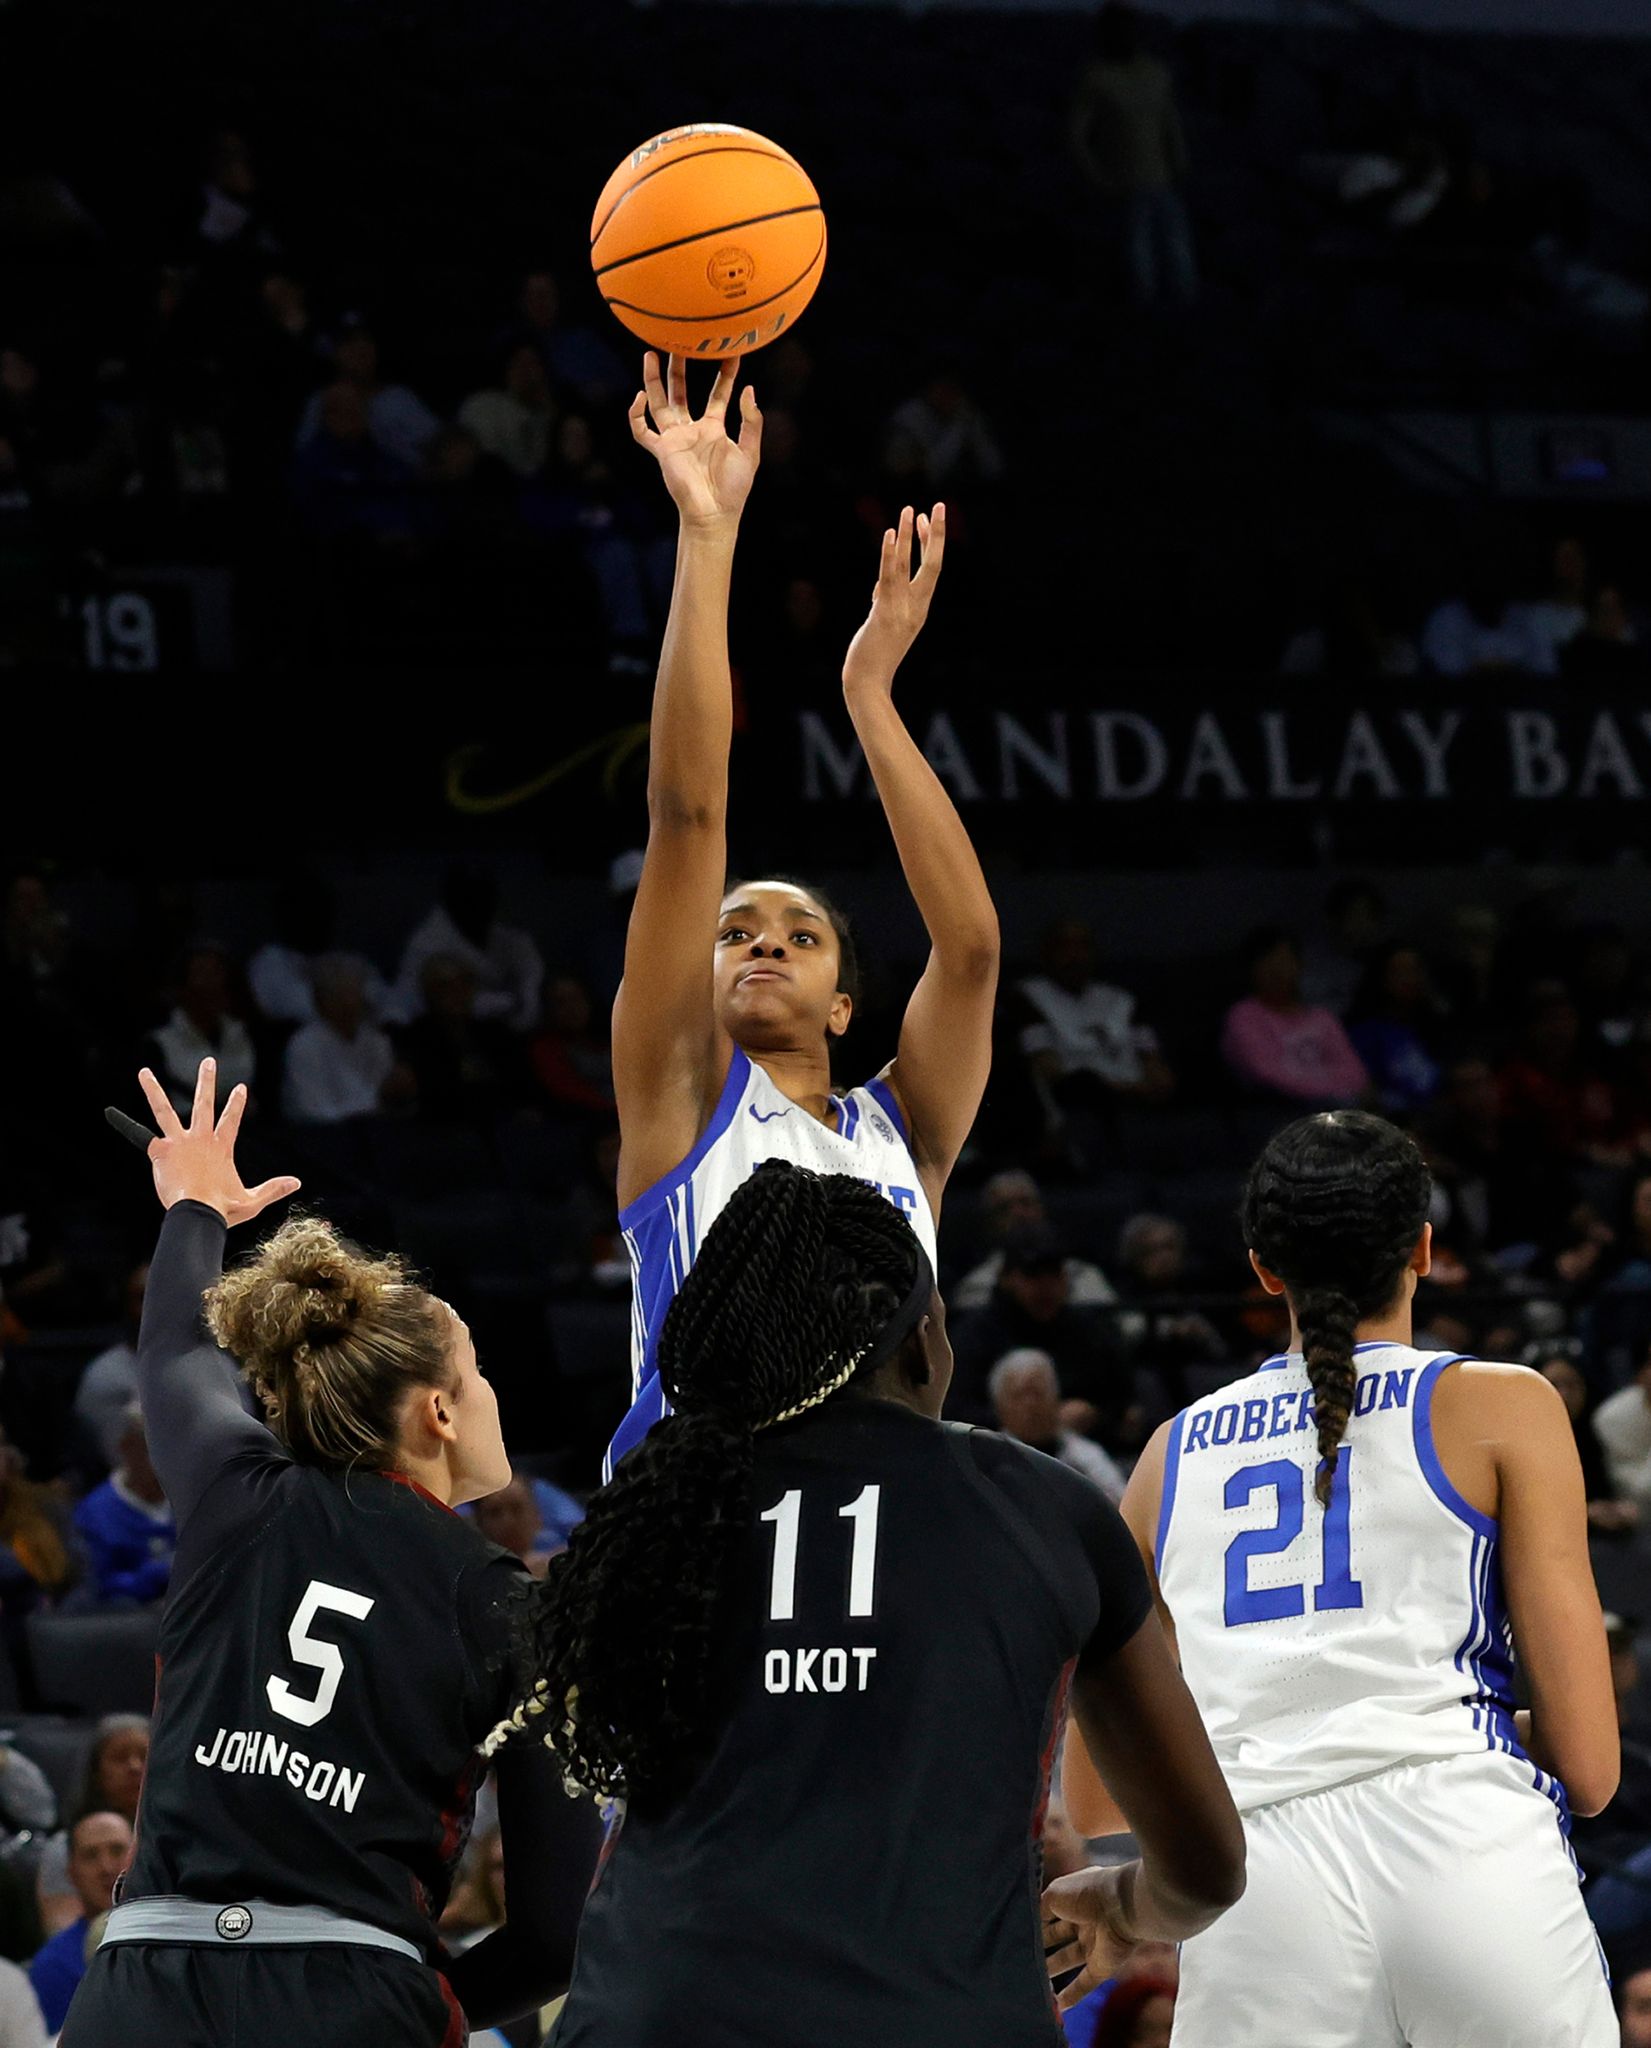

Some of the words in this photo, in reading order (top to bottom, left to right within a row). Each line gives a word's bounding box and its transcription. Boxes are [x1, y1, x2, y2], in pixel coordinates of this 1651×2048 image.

[799, 708, 1467, 801] MANDALAY
[1183, 1367, 1416, 1455] ROBERON
[759, 1484, 881, 1621] 11
[1223, 1445, 1364, 1628] 21
[265, 1579, 377, 1729] 5
[764, 1647, 878, 1694] OKOT
[194, 1727, 367, 1815] JOHNSON
